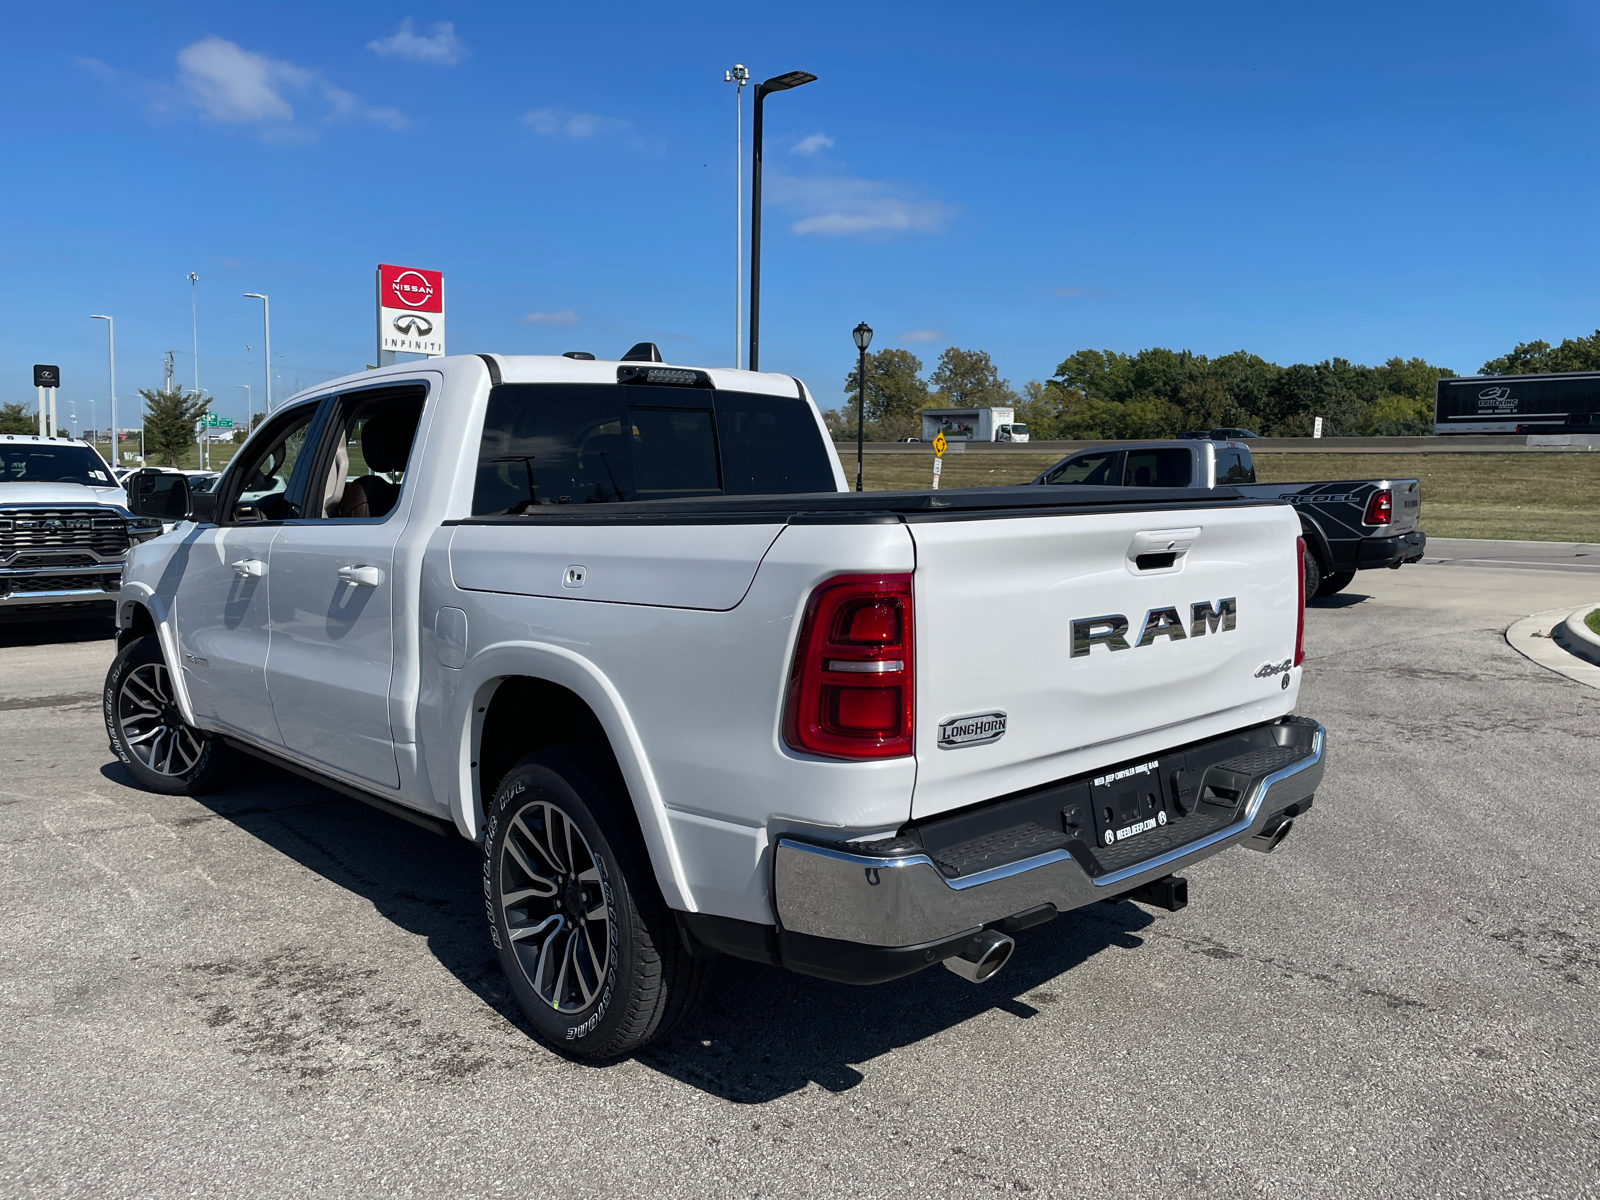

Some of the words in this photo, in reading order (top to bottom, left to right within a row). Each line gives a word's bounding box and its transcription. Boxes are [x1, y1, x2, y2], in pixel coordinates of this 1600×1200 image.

[392, 283, 433, 294] NISSAN
[384, 338, 441, 351] INFINITI
[1478, 399, 1518, 407] TRUCKING
[1280, 494, 1360, 506] REBEL
[16, 518, 91, 529] RAM
[1069, 597, 1236, 658] RAM
[1148, 760, 1159, 769] RAM
[1116, 818, 1157, 840] REEDJEEP.COM
